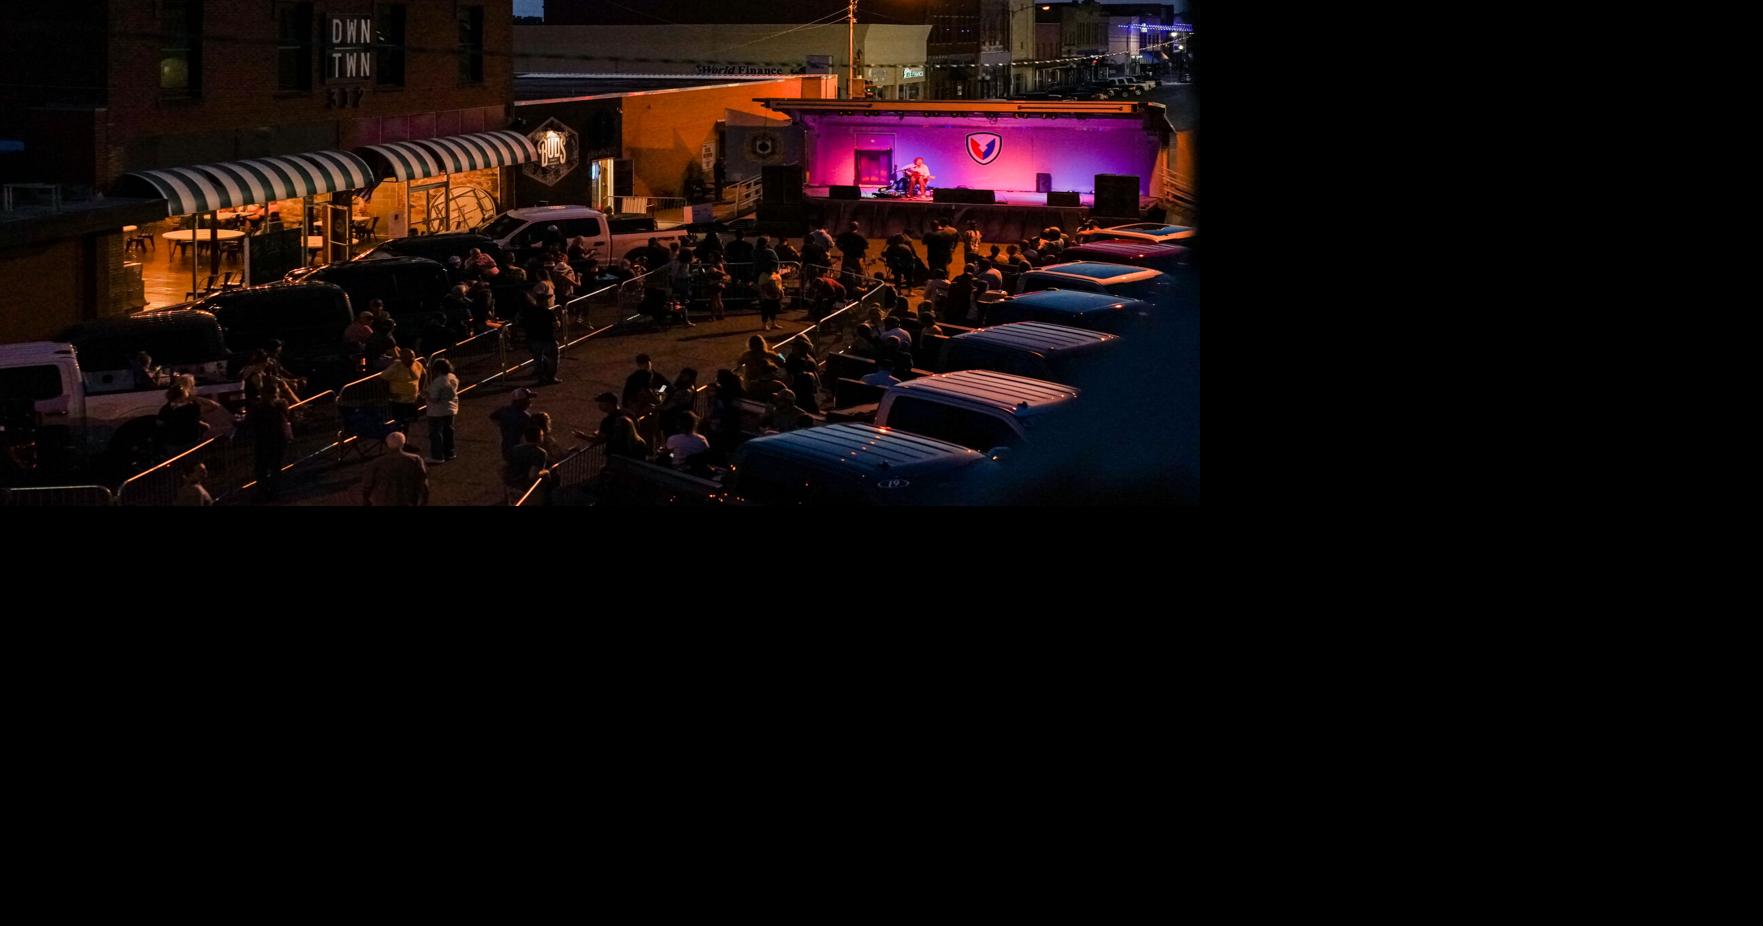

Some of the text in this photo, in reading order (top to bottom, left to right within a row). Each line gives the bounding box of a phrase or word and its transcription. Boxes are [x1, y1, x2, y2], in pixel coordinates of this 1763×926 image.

[332, 18, 371, 44] DWN
[332, 52, 371, 78] TWN
[702, 64, 783, 75] World Finance
[537, 134, 567, 167] BUDS
